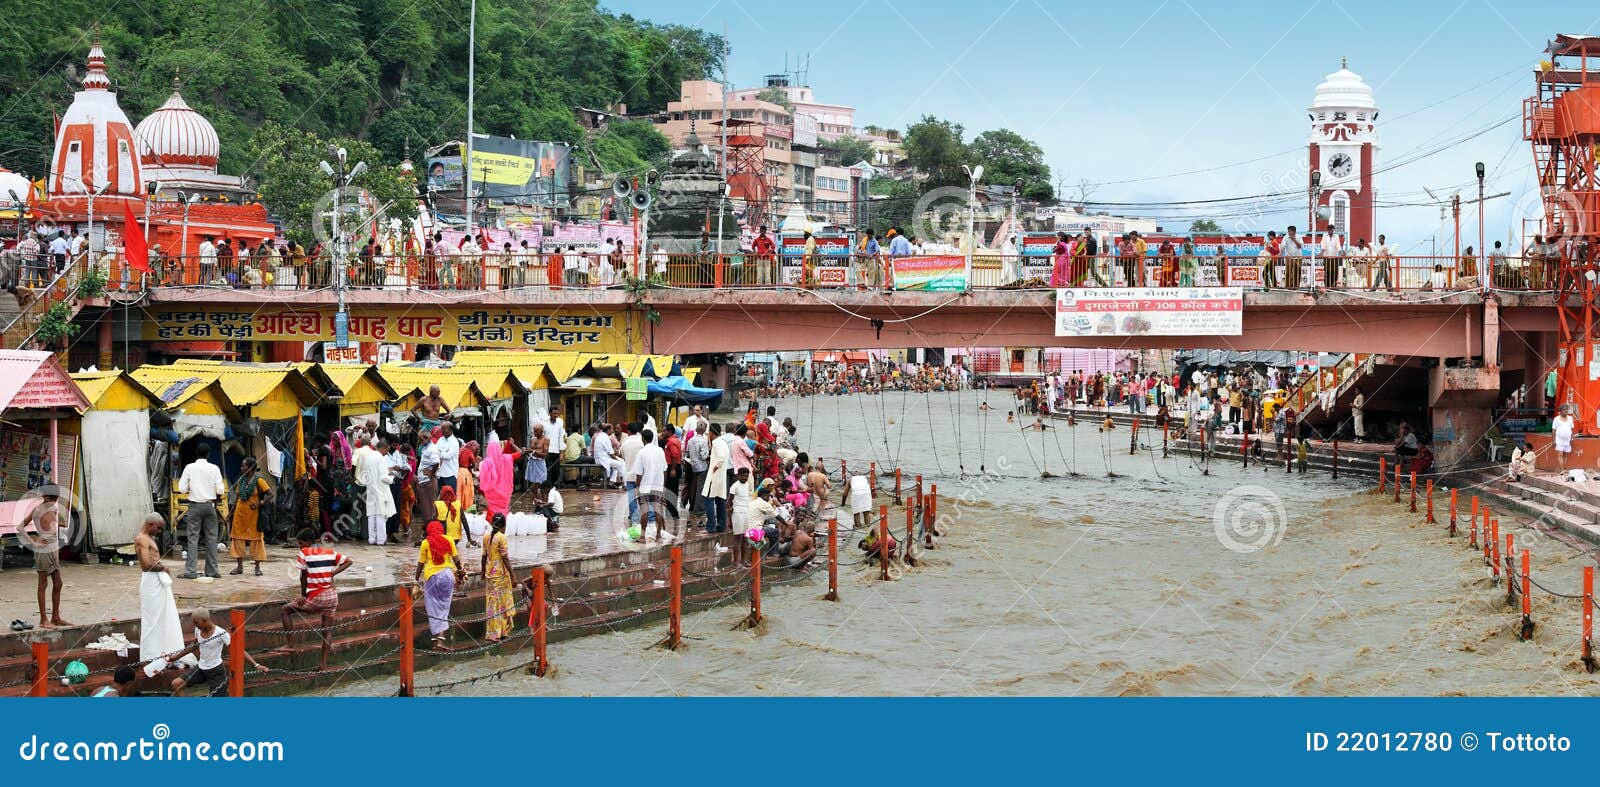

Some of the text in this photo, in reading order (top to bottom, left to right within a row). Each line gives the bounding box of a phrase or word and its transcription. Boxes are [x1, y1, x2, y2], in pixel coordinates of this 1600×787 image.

[1236, 240, 1261, 254] पुलिस
[1084, 300, 1139, 310] इमरजेन्सी
[1156, 302, 1177, 310] 108
[1181, 300, 1207, 310] कॉल
[256, 311, 323, 335] अस्थि
[397, 315, 444, 339] घाट
[458, 310, 614, 329] श्री गंगा सभा
[158, 326, 185, 339] हर
[188, 324, 213, 338] की
[522, 327, 601, 345] हरिद्वार
